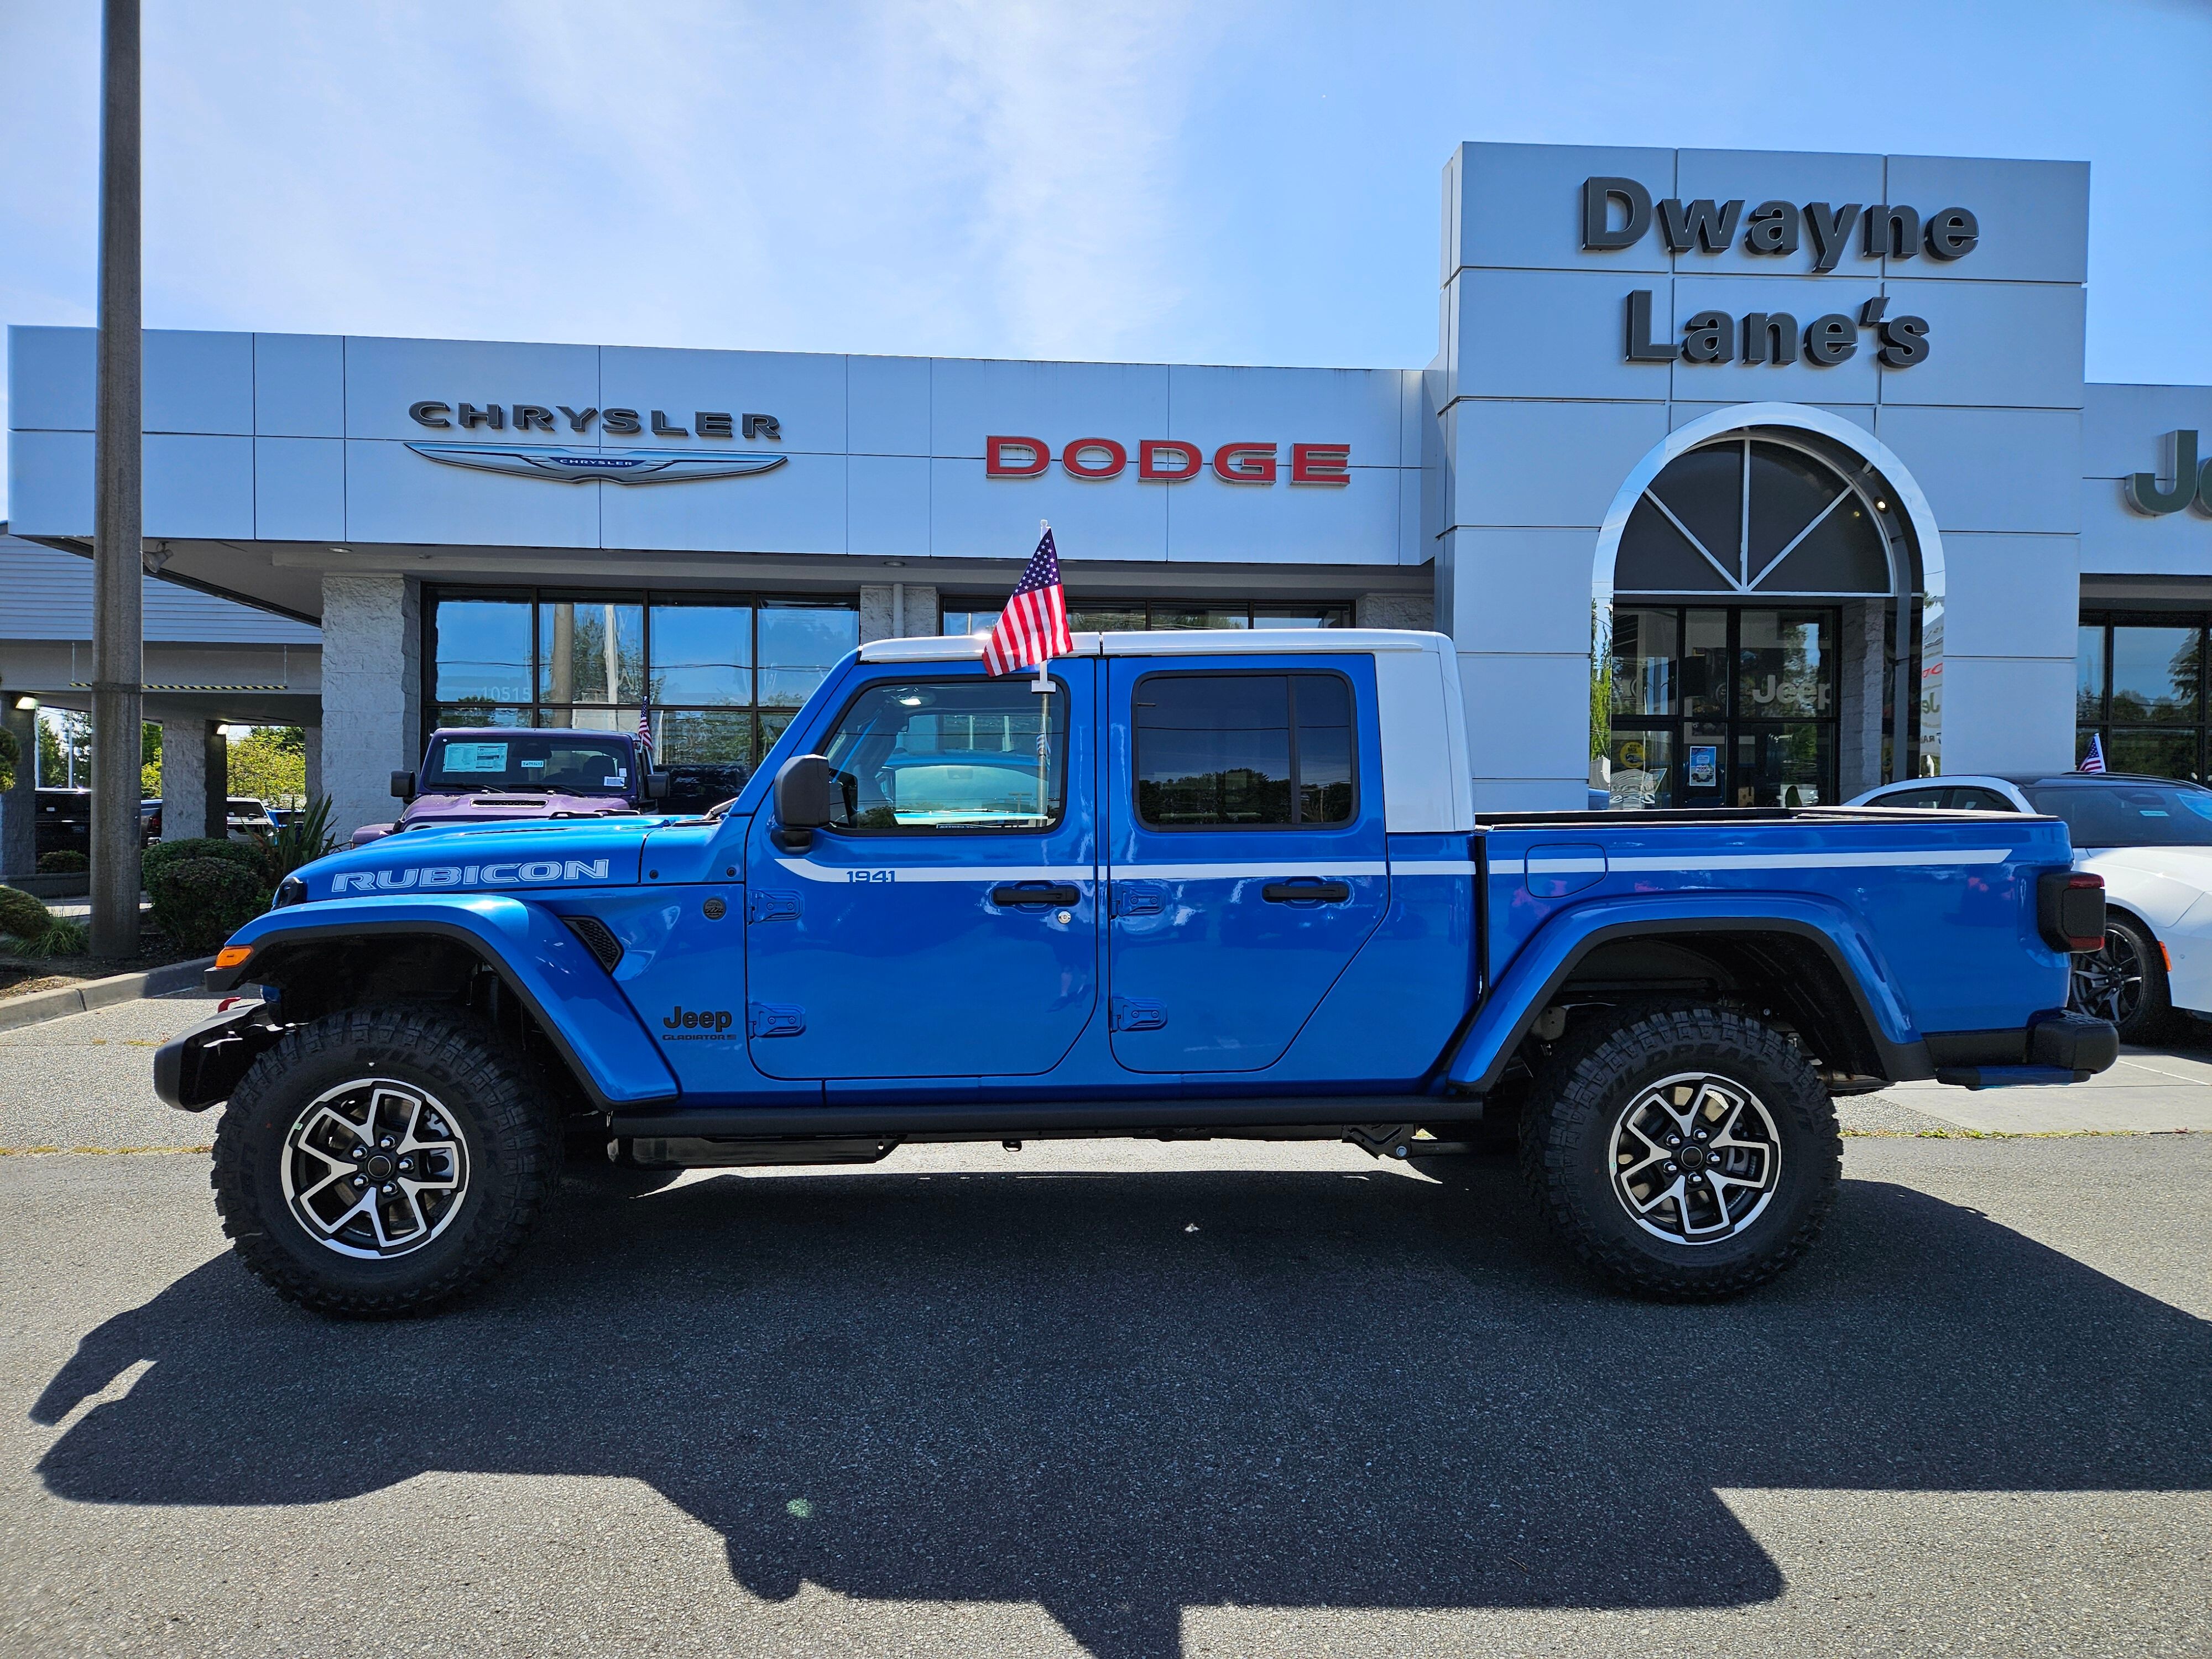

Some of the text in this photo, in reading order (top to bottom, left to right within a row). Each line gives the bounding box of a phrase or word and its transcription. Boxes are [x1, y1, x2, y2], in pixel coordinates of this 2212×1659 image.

[1582, 176, 1980, 273] Dwayne
[1625, 289, 1930, 368] Lane's
[408, 400, 781, 440] CHRYSLER
[985, 435, 1350, 486] DODGE
[2124, 429, 2212, 518] J
[481, 686, 531, 702] 10515
[331, 859, 609, 892] RUBICON
[847, 870, 895, 883] 1941
[663, 1006, 732, 1032] Jeep
